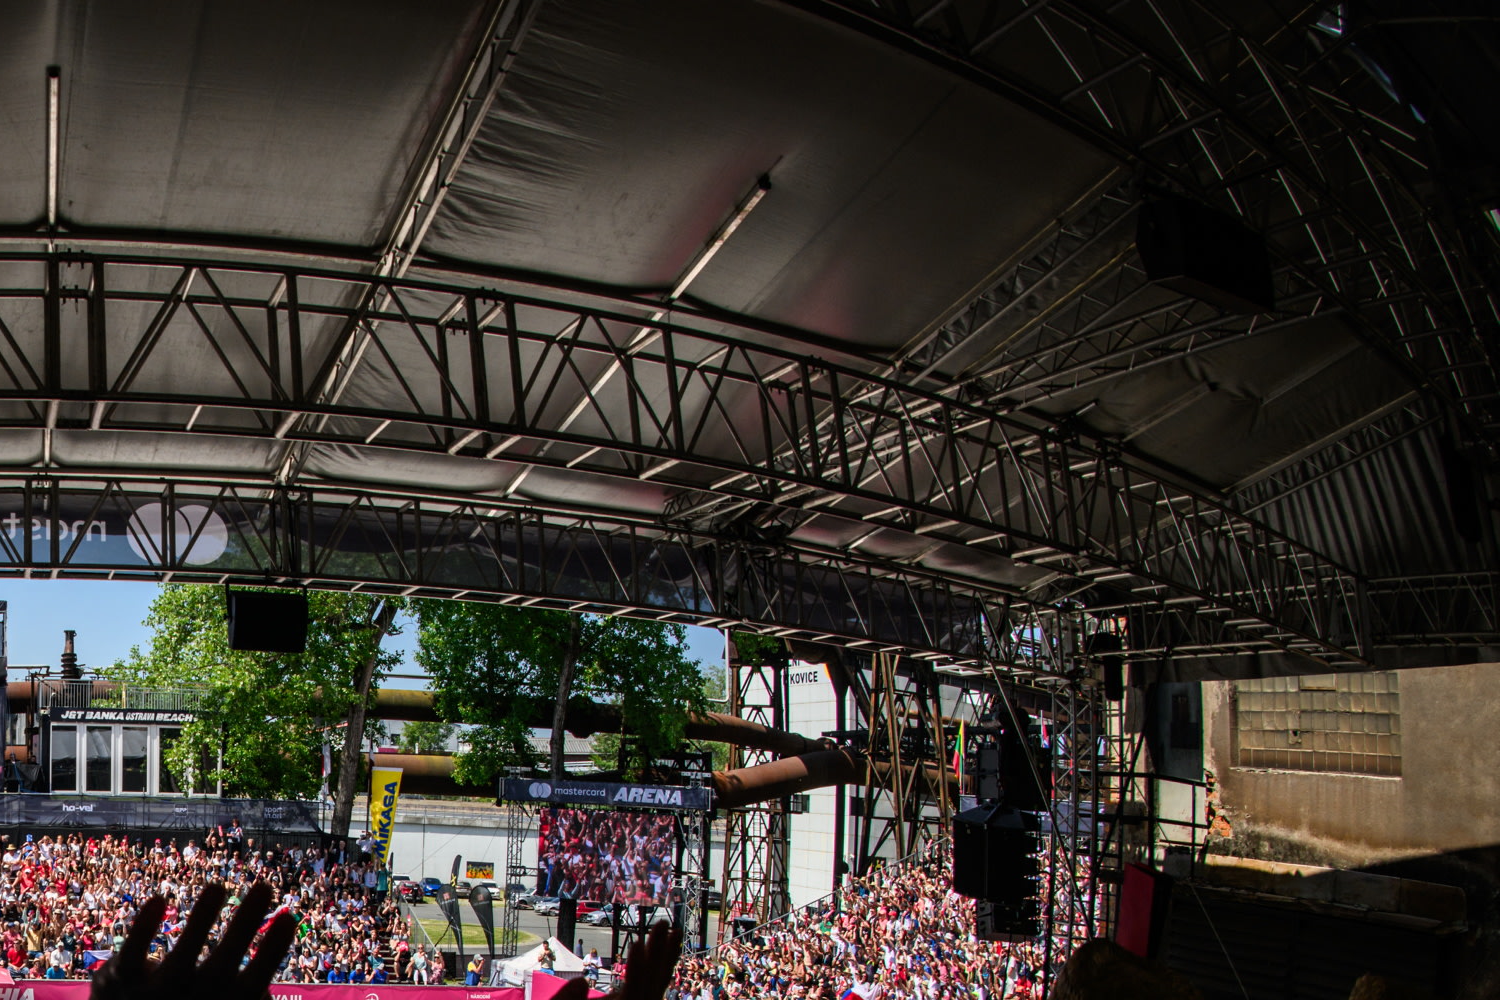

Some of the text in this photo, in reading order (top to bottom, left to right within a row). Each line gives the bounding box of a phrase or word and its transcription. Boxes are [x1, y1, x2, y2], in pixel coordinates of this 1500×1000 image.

[789, 671, 818, 684] KOVICE
[61, 711, 84, 719] J&T
[85, 711, 124, 720] BANKA
[155, 713, 194, 722] BEACH
[554, 787, 683, 806] mastercard ARENA
